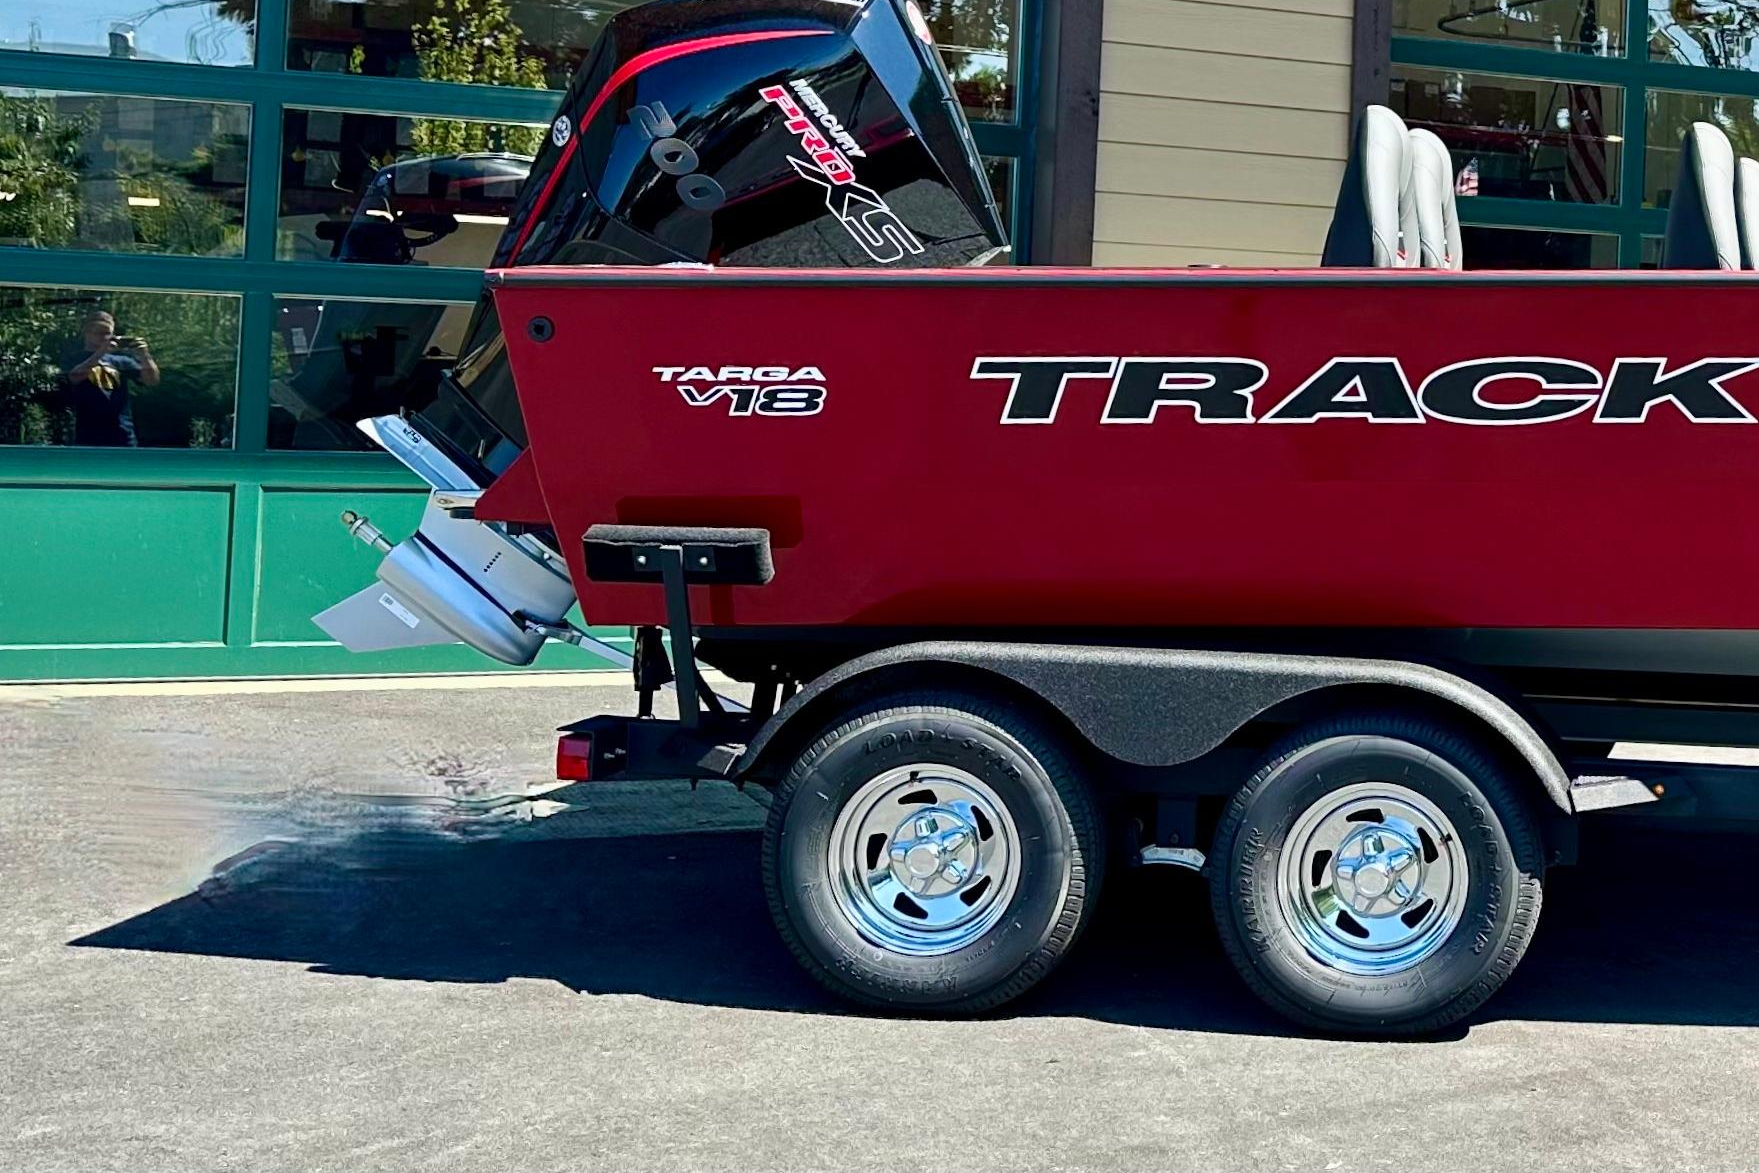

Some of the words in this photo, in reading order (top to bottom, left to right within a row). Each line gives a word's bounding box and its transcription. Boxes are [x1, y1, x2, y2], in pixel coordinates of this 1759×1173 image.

[627, 100, 727, 211] 200
[759, 84, 856, 186] PRO
[788, 78, 867, 158] MERCURY
[786, 155, 925, 263] XS
[652, 366, 827, 382] TARGA
[677, 384, 827, 417] V18
[862, 728, 936, 757] LOAD
